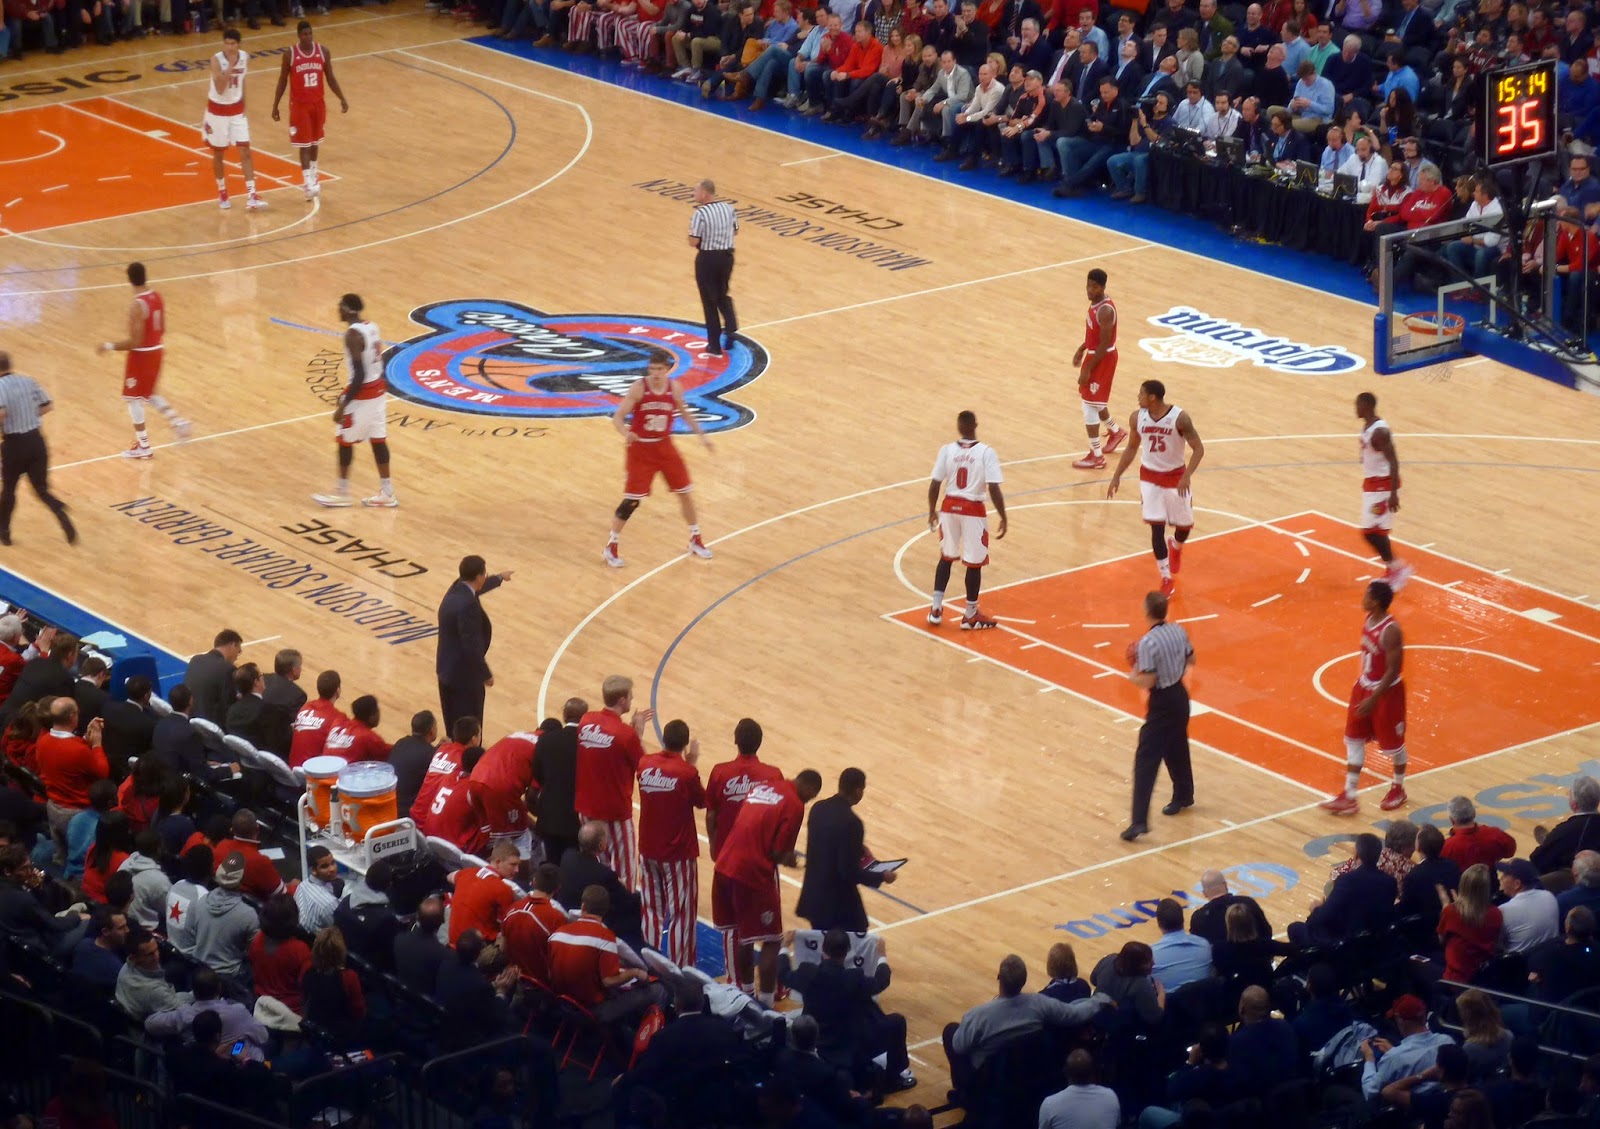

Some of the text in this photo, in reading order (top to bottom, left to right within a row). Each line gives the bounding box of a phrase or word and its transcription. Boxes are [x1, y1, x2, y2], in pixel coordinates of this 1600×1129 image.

[303, 72, 318, 88] 12
[1498, 71, 1546, 102] 15:14
[1498, 100, 1540, 153] 35
[775, 191, 904, 231] CHASE
[803, 231, 934, 272] MADISON
[463, 311, 606, 358] Classic
[627, 325, 723, 359] 2014
[1156, 311, 1358, 373] Corona
[415, 368, 504, 404] MEN'S
[1148, 434, 1166, 453] 25
[956, 466, 968, 490] 0
[281, 518, 429, 579] CHASE
[109, 496, 440, 646] MADISON SQUARE GARDEN
[579, 723, 615, 749] Indiana
[639, 766, 679, 794] Indiana
[723, 774, 768, 803] Indi
[431, 786, 453, 815] 5
[382, 836, 410, 850] SERIES
[1054, 861, 1301, 939] Crona
